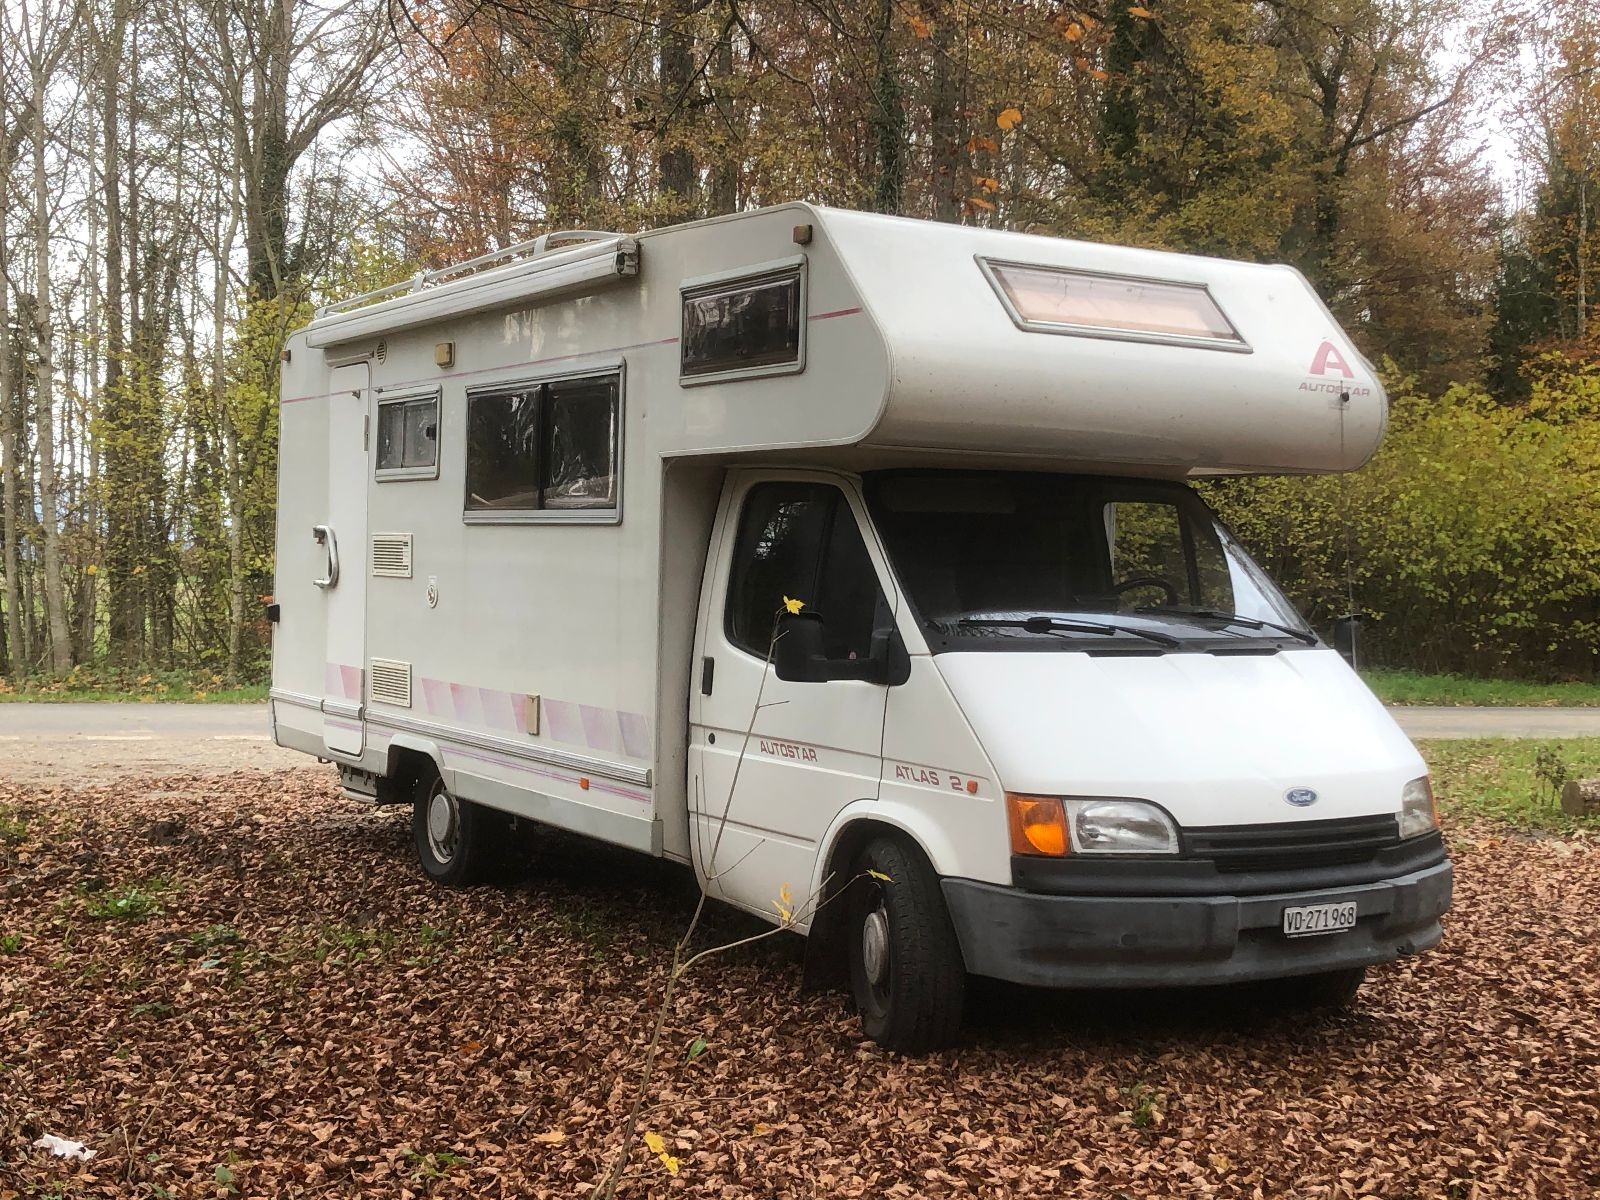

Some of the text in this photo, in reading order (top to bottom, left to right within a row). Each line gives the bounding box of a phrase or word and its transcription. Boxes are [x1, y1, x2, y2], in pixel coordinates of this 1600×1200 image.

[1309, 341, 1354, 378] A
[1299, 382, 1370, 397] AUTOSTAR
[760, 740, 818, 762] AUTOSTAR
[895, 764, 964, 791] ATLAS 2
[1291, 791, 1312, 802] Ford
